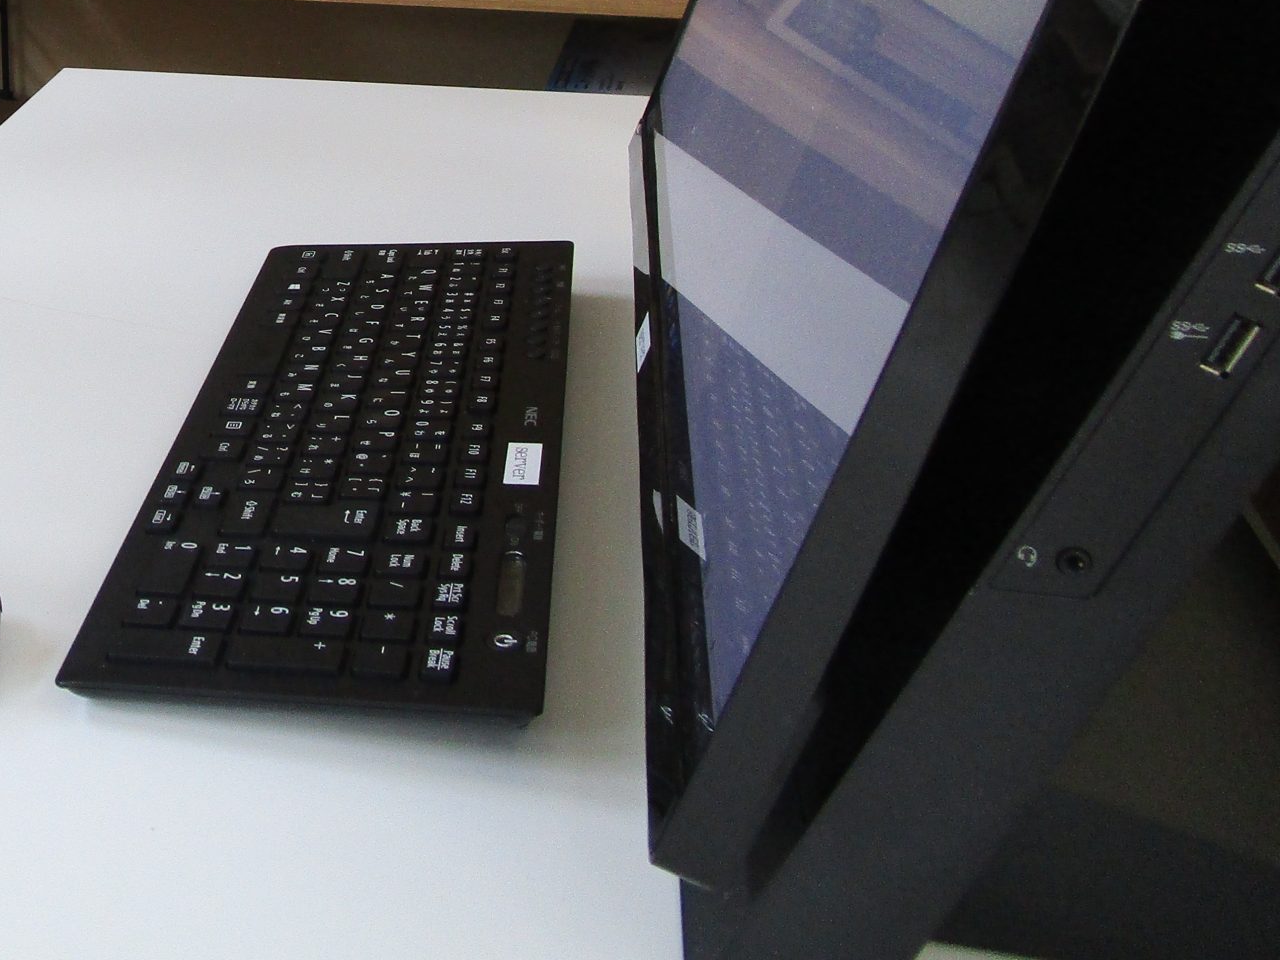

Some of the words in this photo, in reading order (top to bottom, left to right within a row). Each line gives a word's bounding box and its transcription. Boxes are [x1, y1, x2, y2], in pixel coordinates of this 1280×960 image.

[524, 407, 538, 426] NEC
[218, 443, 230, 451] Ctrl
[510, 445, 528, 480] server
[241, 504, 257, 519] Shift
[354, 510, 367, 524] Enter
[396, 519, 409, 534] Space
[410, 519, 422, 531] Back
[455, 526, 467, 542] Insert
[164, 541, 176, 549] Ins
[216, 543, 228, 553] End
[327, 548, 339, 563] Home
[389, 554, 401, 567] Lock
[403, 555, 414, 567] Num
[451, 554, 463, 571] Delete
[138, 599, 149, 609] Del
[433, 617, 445, 632] Lock
[445, 616, 458, 634] Scroll
[189, 637, 205, 654] Enter
[427, 648, 440, 670] Break
[439, 648, 454, 670] Pause
